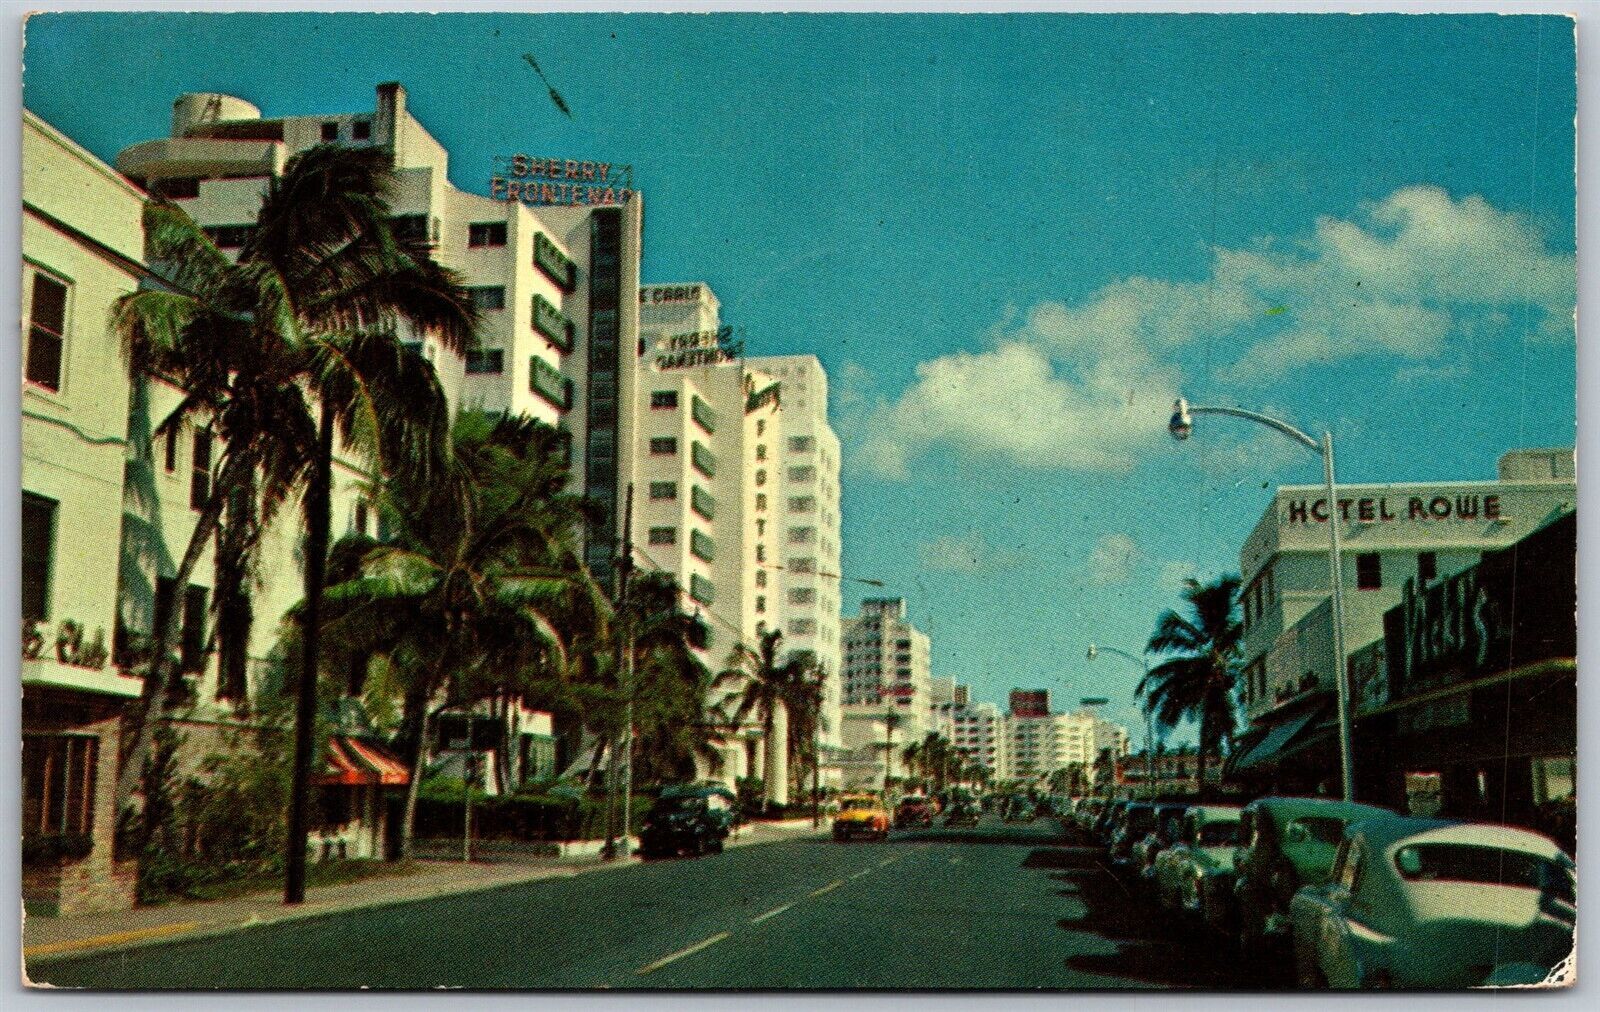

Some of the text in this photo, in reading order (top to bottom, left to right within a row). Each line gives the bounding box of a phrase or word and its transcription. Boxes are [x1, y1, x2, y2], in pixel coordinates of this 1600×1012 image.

[511, 152, 611, 182] SHERRY
[491, 176, 634, 207] FRONTENAC
[1288, 495, 1500, 523] HOTEL ROWE
